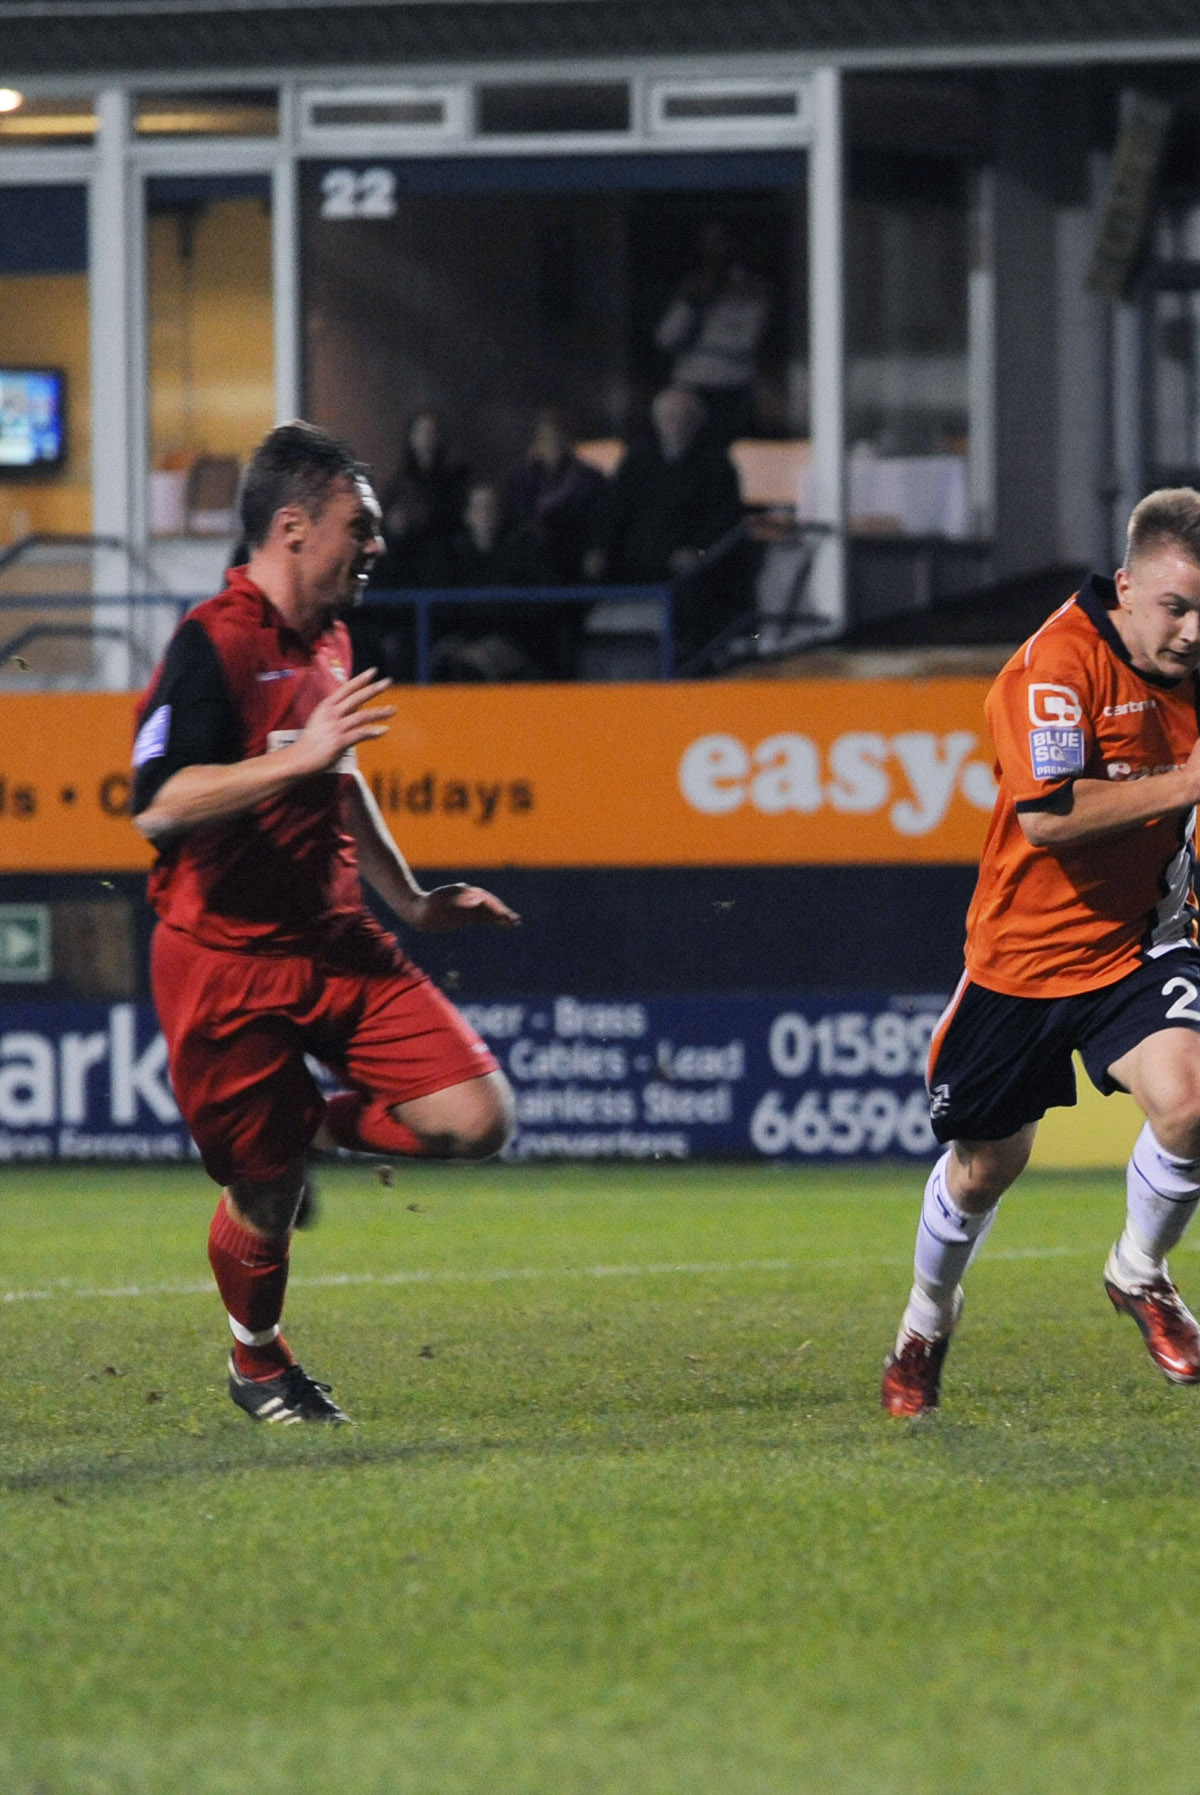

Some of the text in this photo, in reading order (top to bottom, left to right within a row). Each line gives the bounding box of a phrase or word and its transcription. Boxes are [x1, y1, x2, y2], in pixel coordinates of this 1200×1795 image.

[321, 167, 397, 219] 22
[1032, 731, 1080, 748] BLUE
[1034, 745, 1066, 763] SQ
[751, 1087, 938, 1155] 66596
